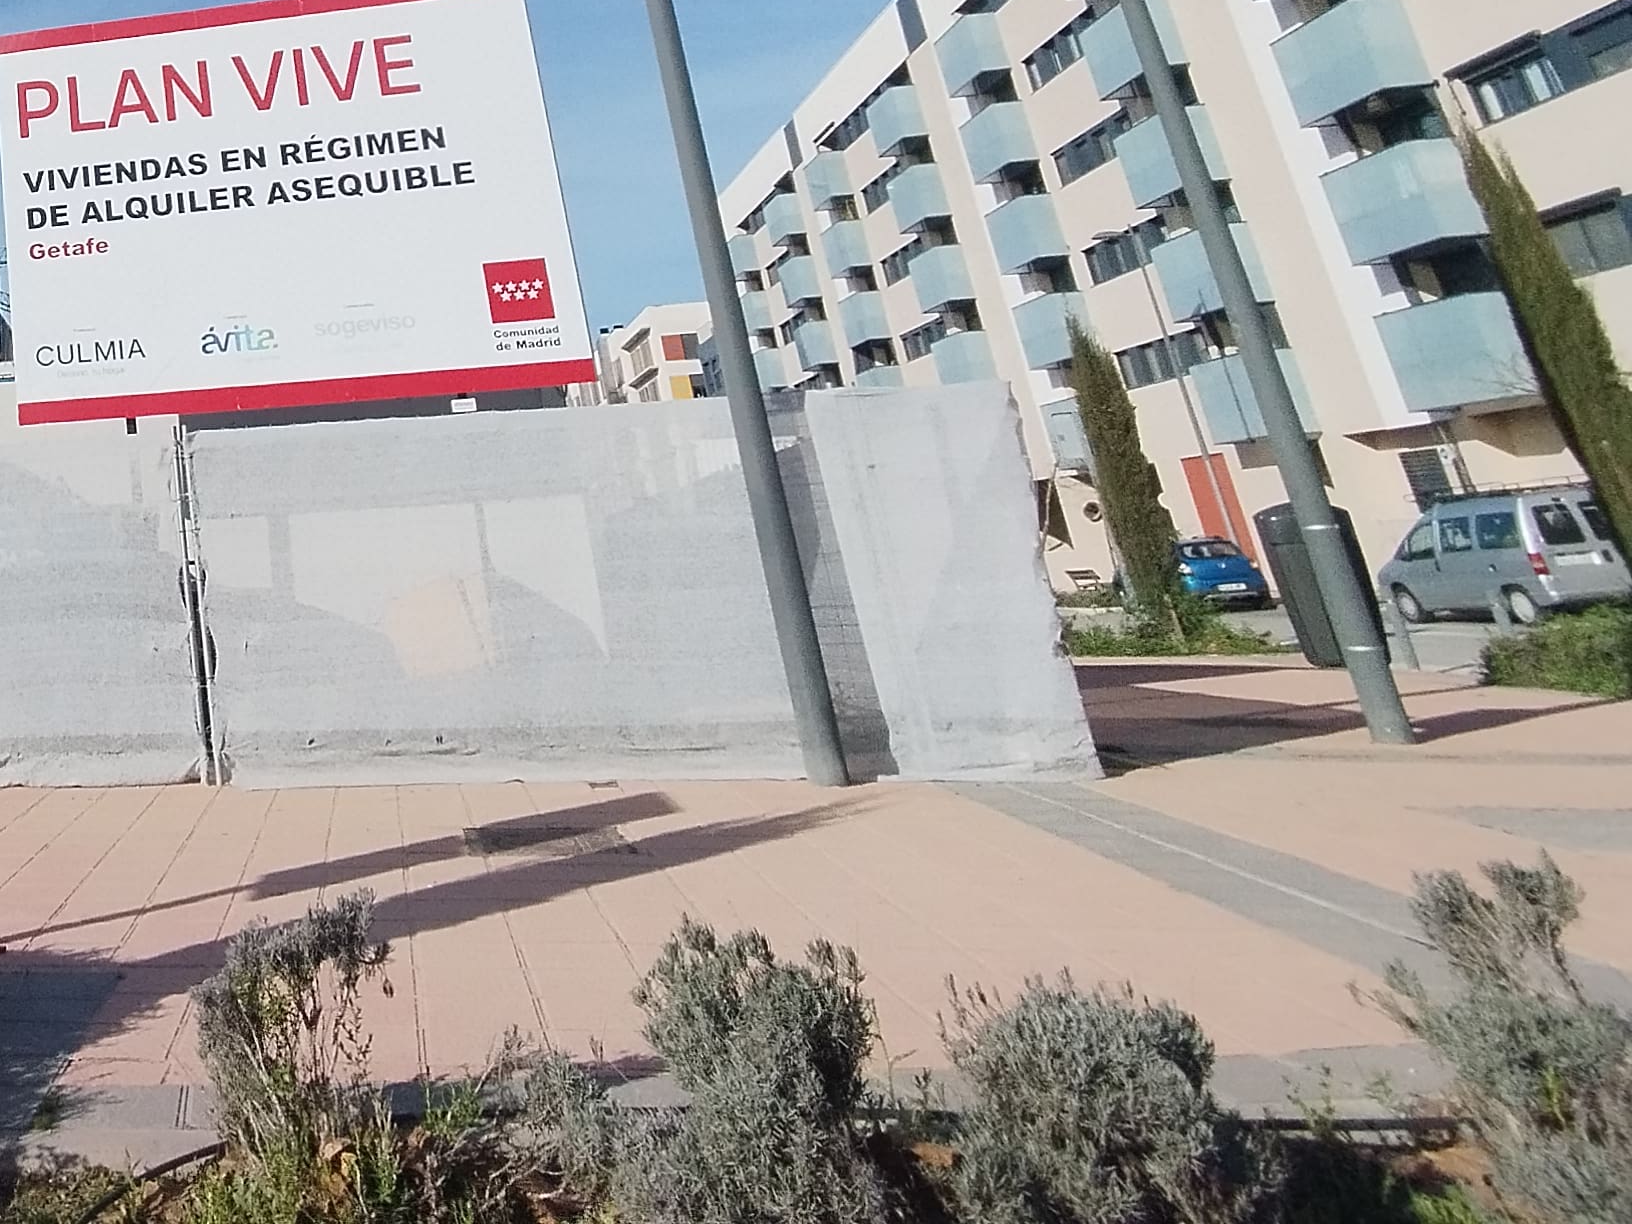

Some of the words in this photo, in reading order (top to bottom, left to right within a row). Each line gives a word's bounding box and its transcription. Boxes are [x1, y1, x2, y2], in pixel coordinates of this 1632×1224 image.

[16, 59, 213, 138] PLAN
[231, 34, 422, 111] VIVE
[23, 152, 209, 194] VIVIENDAS
[220, 145, 268, 172] EN
[280, 126, 447, 166] RÉGIMEN
[26, 204, 70, 230] DE
[81, 185, 256, 225] ALQUILER
[267, 161, 476, 206] ASEQUIBLE
[28, 237, 111, 261] Getafe
[313, 314, 416, 339] sogeviso
[493, 325, 560, 339] Comunidad
[35, 338, 146, 367] CULMIA
[496, 341, 511, 351] de
[516, 337, 561, 350] Madrid
